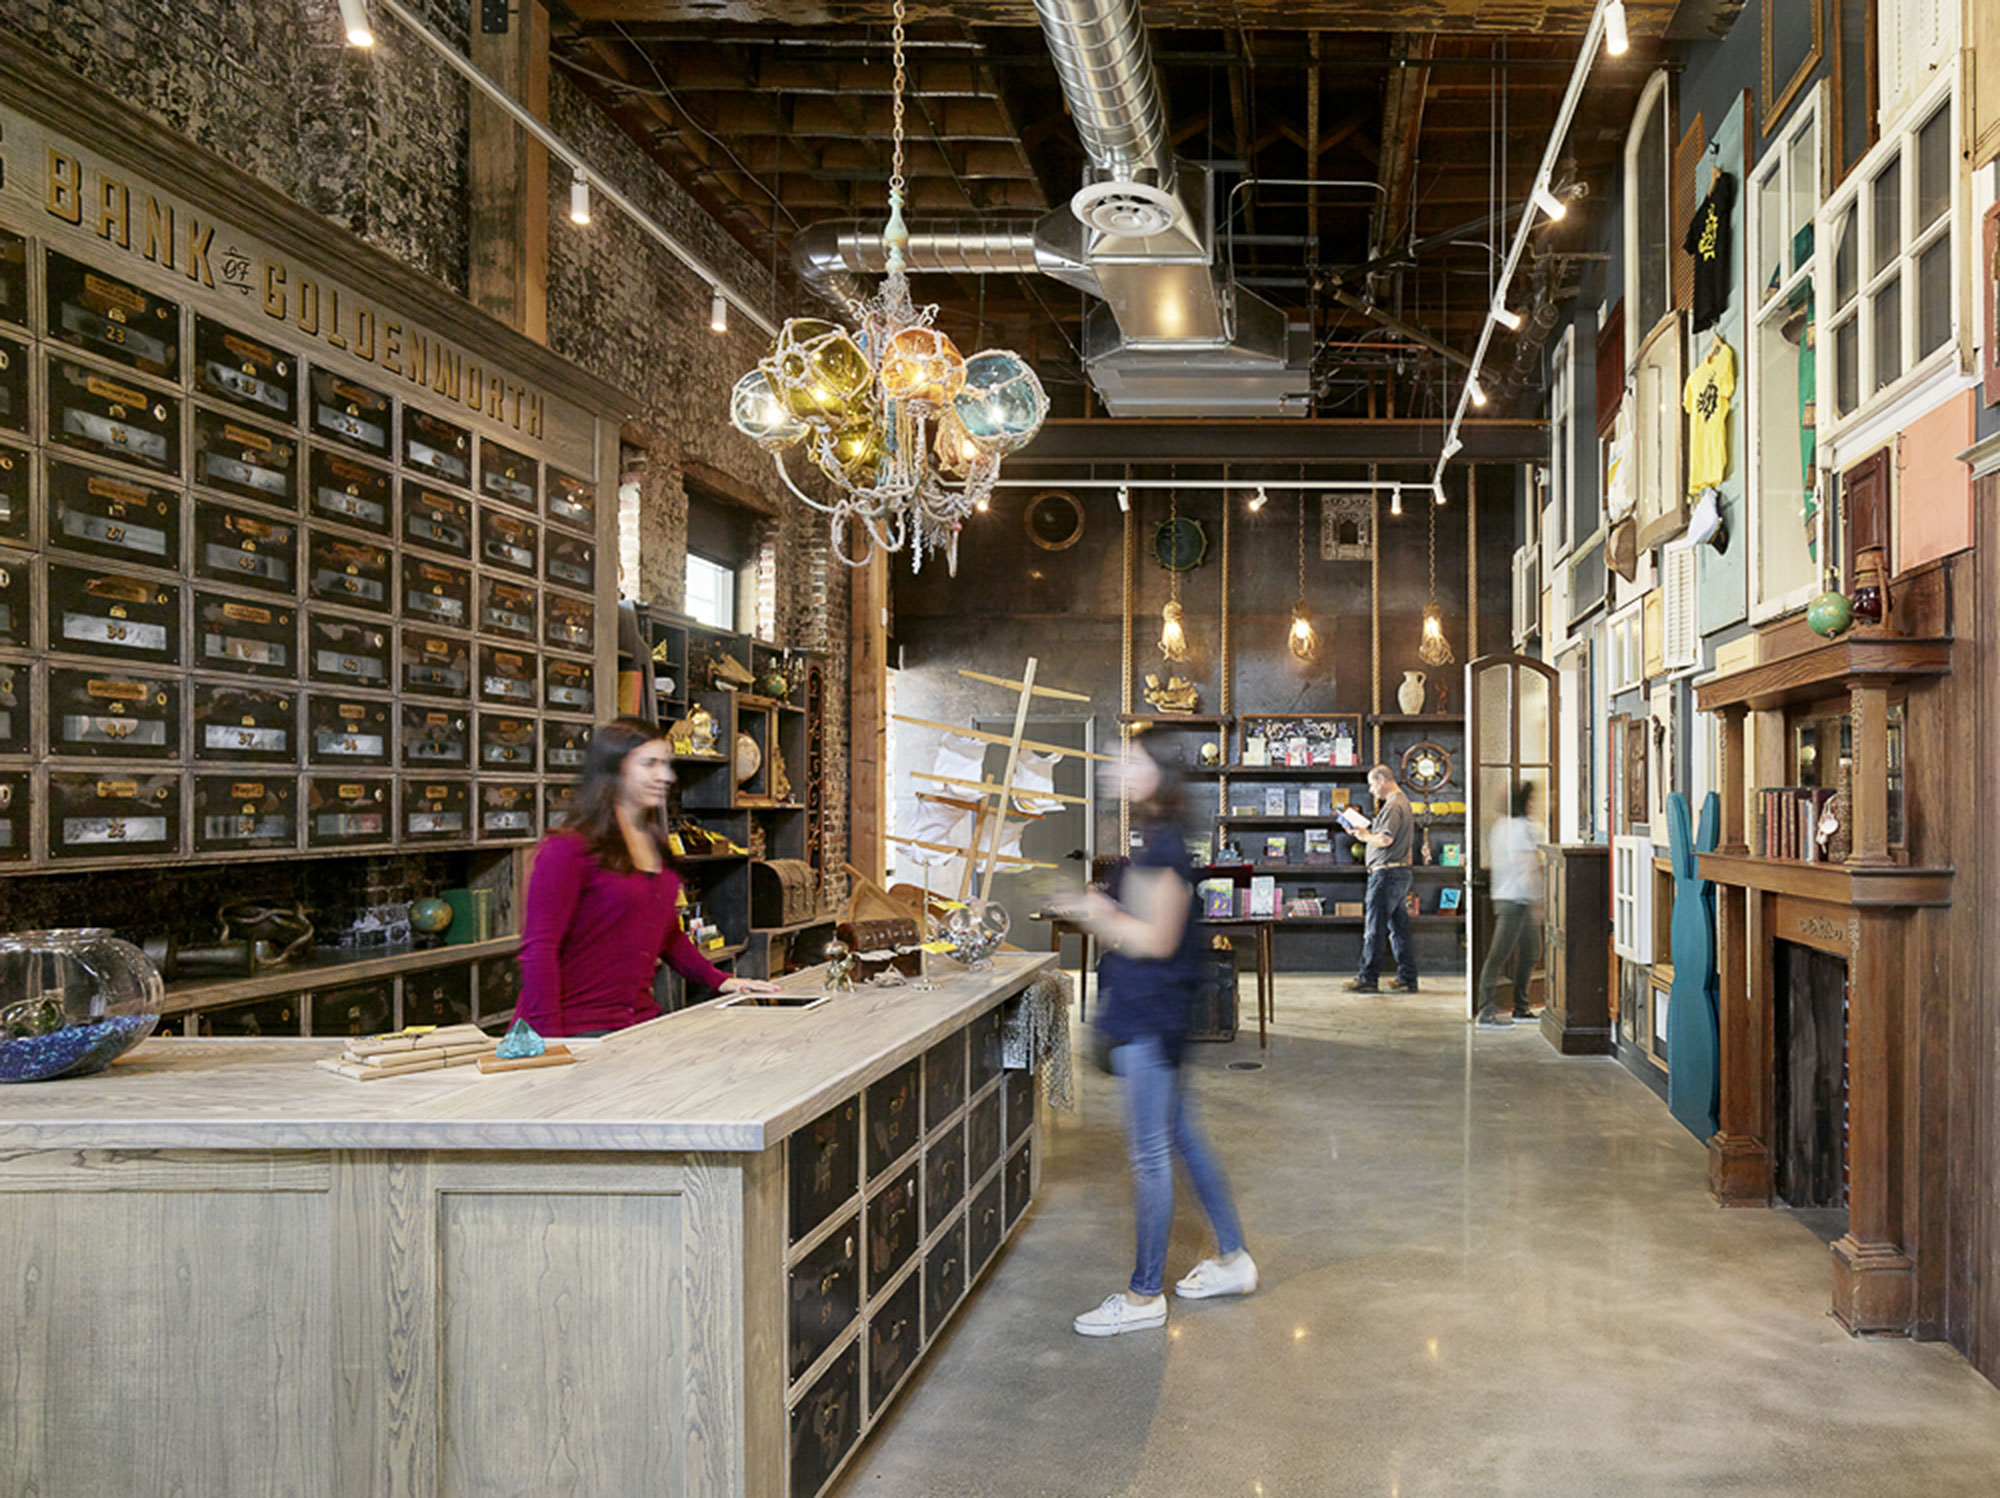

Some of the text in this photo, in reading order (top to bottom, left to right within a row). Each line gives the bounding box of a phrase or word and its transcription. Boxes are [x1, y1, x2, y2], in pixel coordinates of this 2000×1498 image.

[46, 147, 215, 290] BANK
[263, 259, 543, 440] GOLDENWORTH
[106, 325, 125, 343] 23
[106, 623, 127, 640] 30
